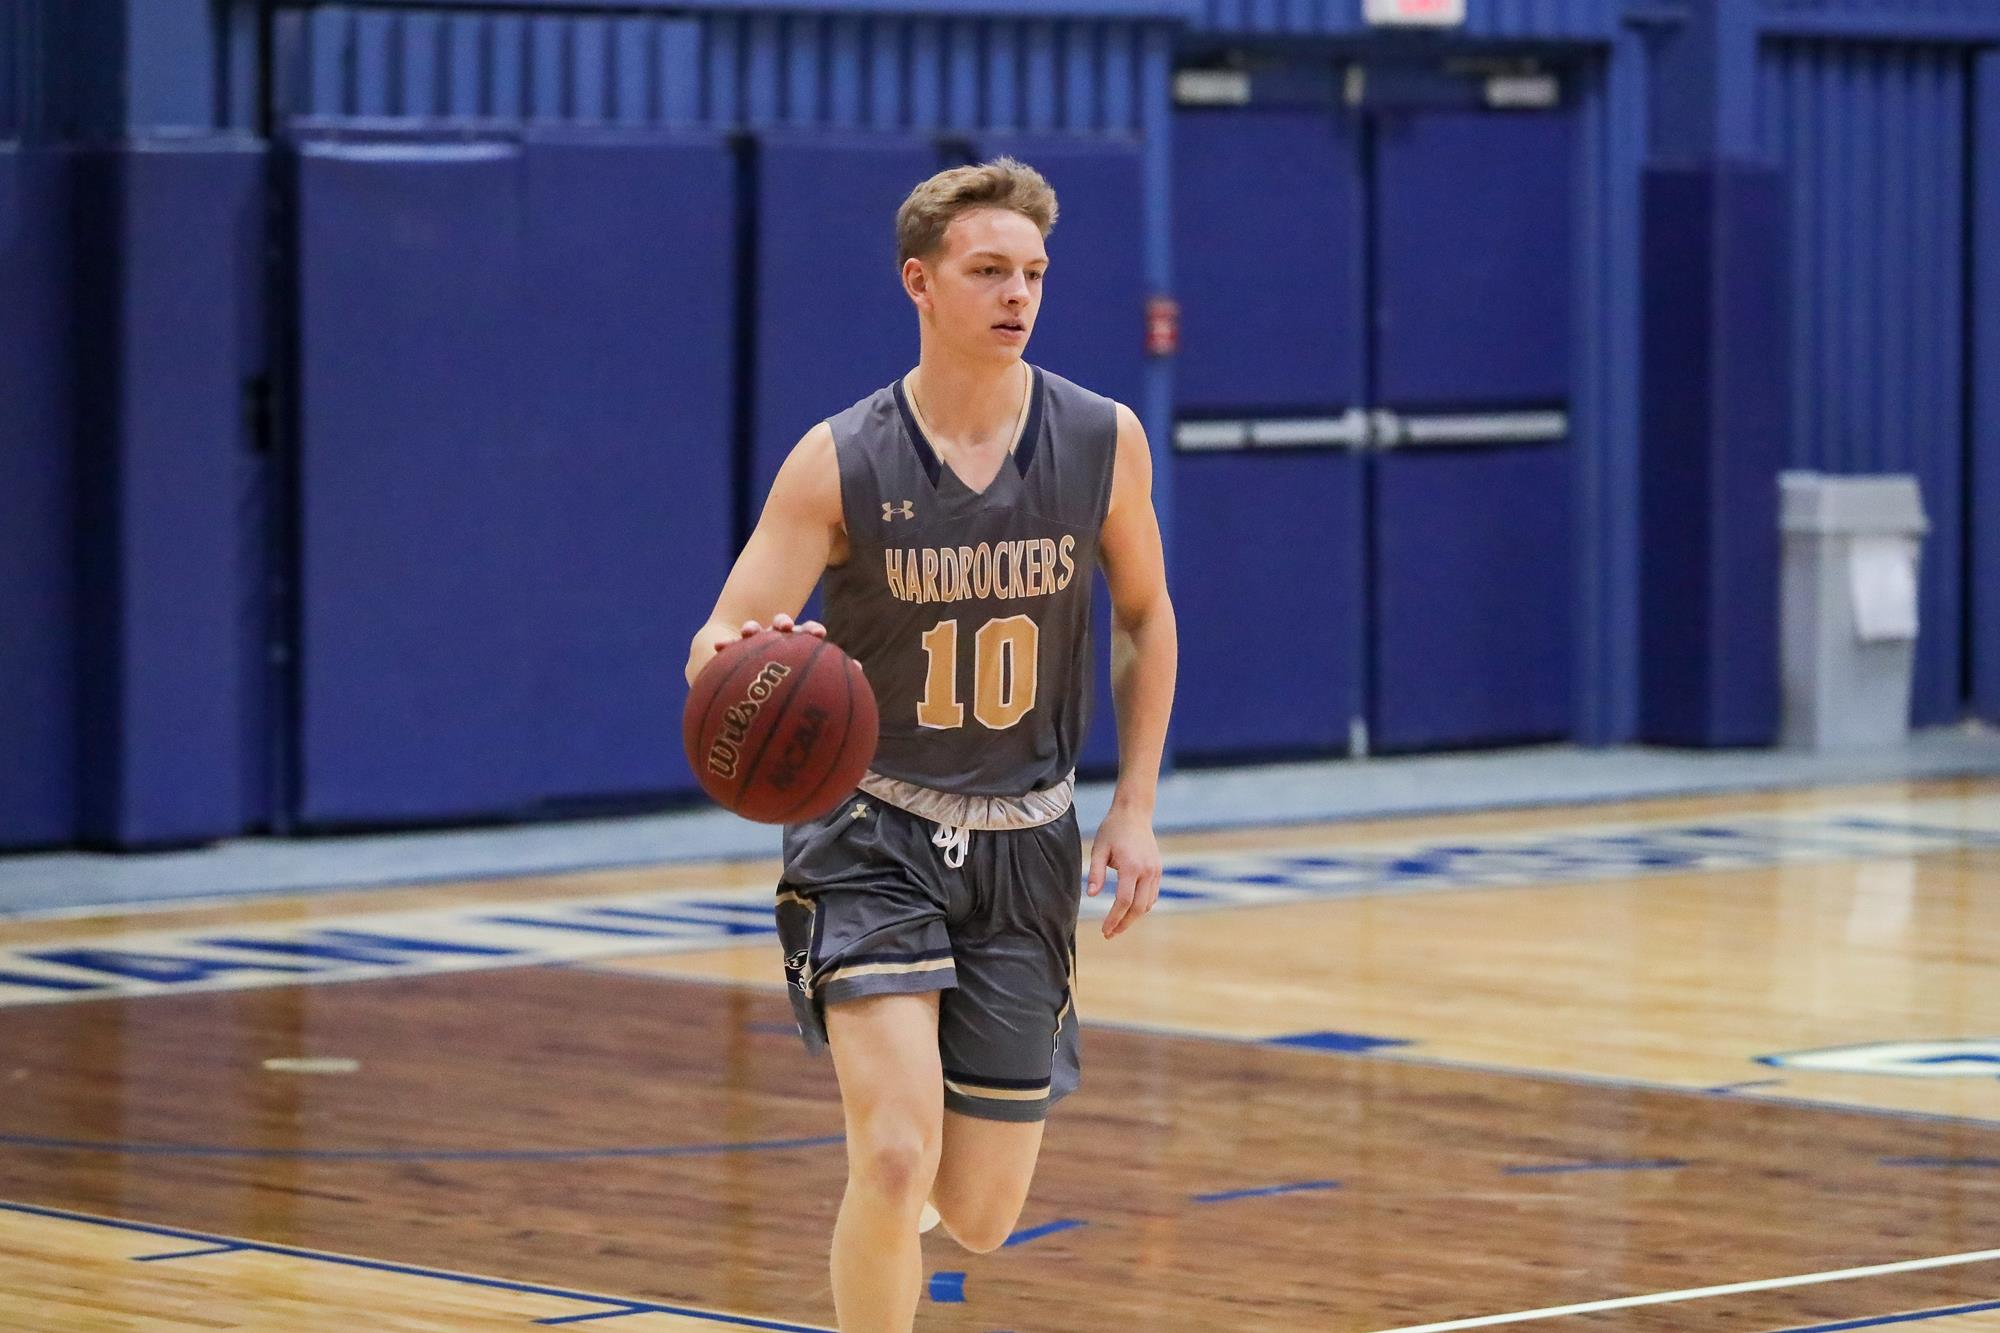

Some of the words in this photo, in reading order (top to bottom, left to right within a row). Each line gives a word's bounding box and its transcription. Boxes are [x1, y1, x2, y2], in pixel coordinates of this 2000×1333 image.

[885, 534, 1076, 604] HARDROCKERS
[708, 661, 791, 779] Wilson
[916, 614, 1040, 730] 10
